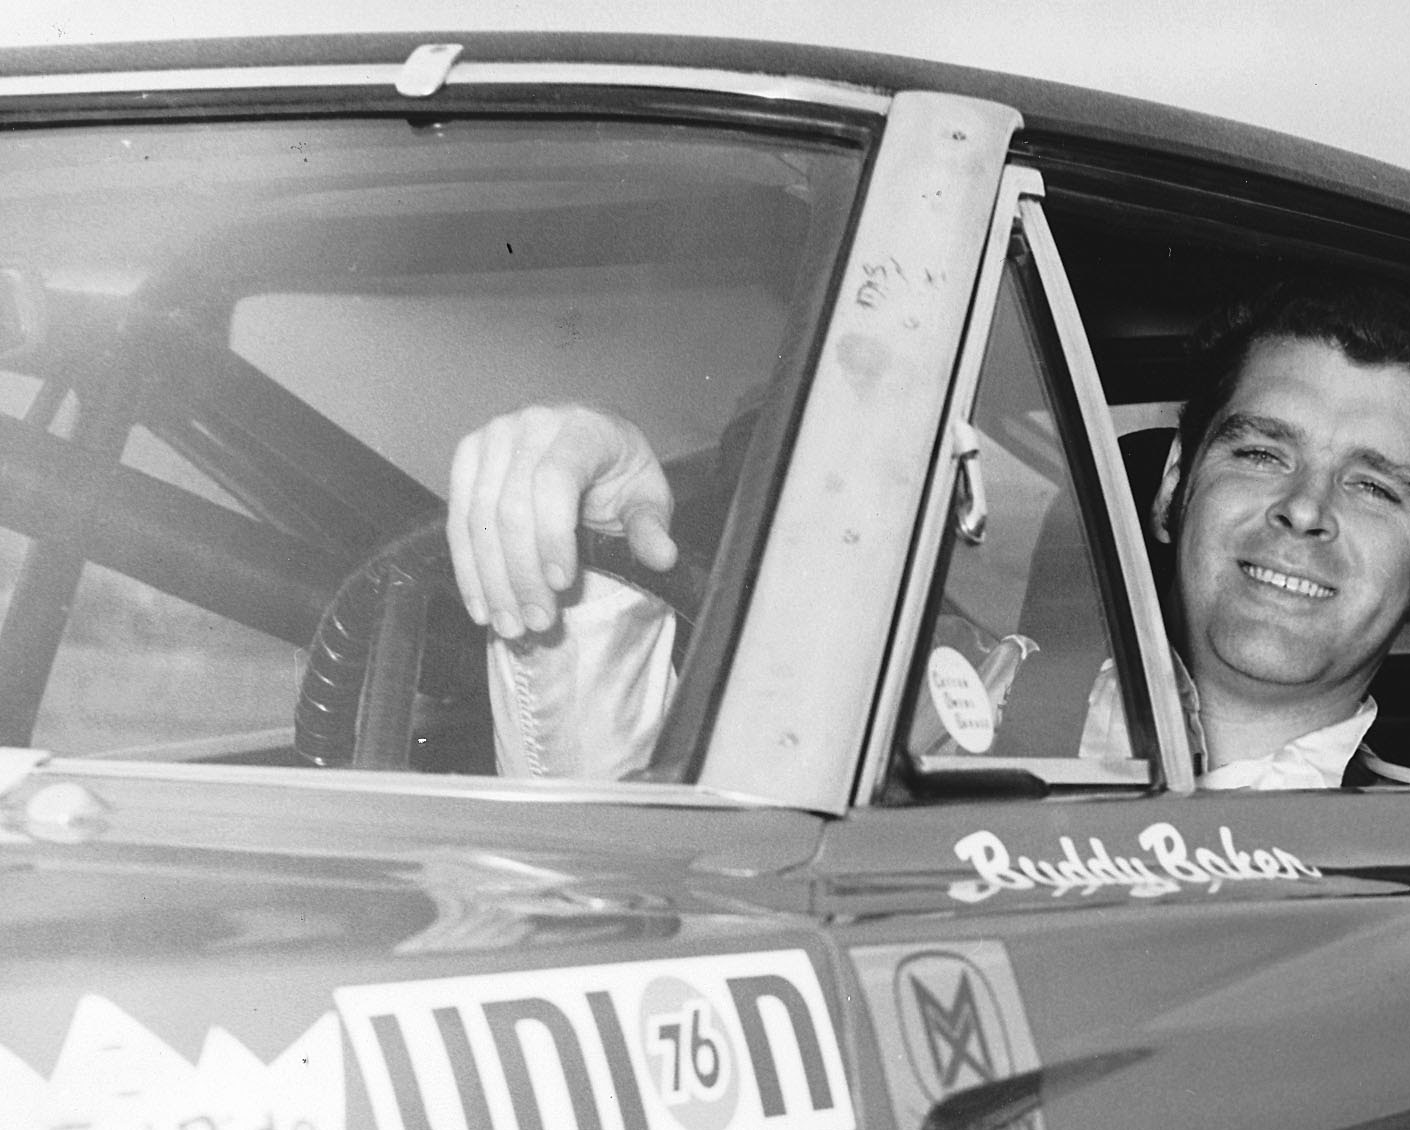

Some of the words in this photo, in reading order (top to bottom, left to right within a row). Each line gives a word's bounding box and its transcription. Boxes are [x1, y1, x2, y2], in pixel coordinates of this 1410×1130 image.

[947, 829, 1181, 902] Buddy
[1138, 822, 1322, 893] Baker
[656, 1006, 722, 1094] 76
